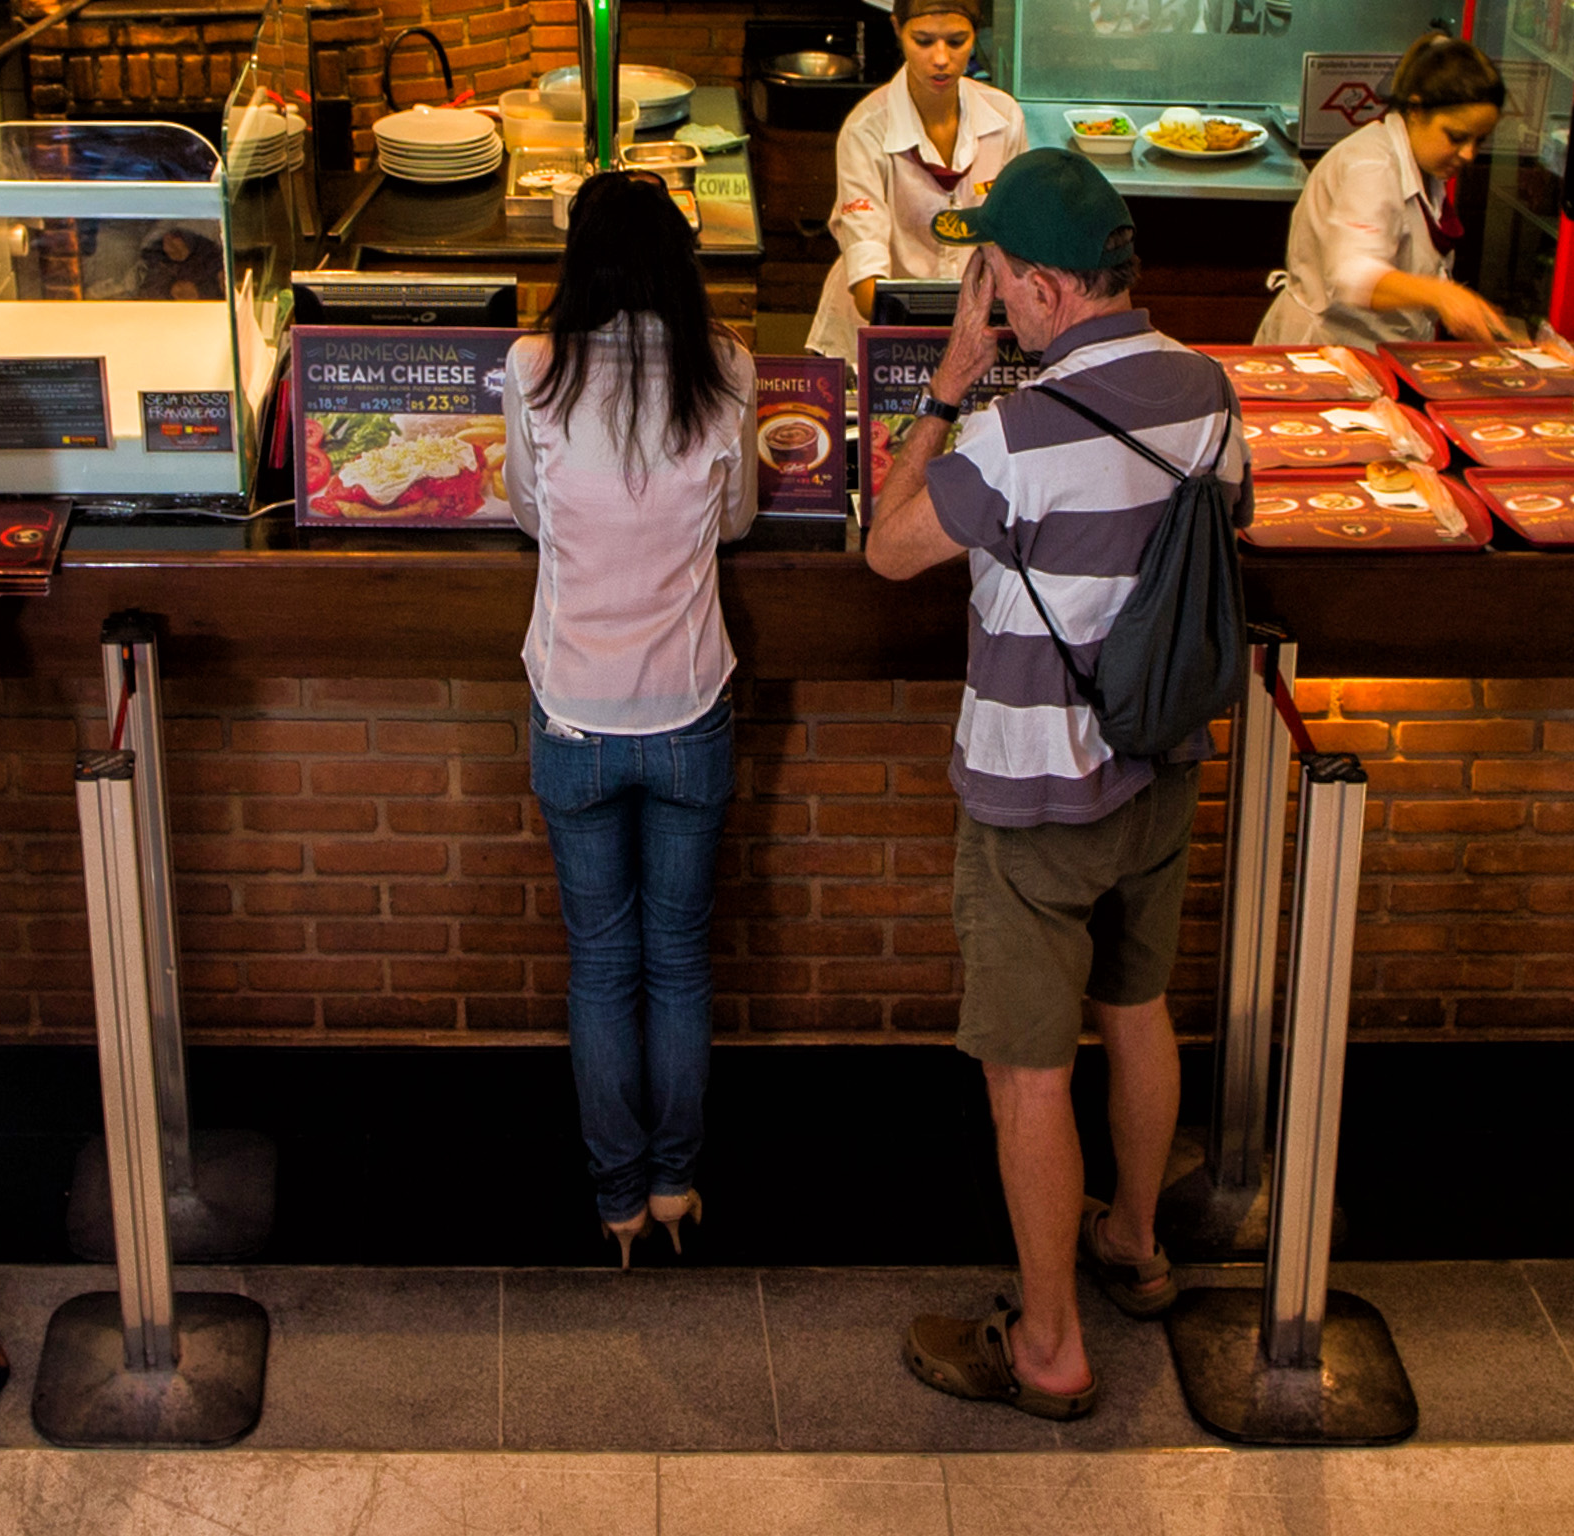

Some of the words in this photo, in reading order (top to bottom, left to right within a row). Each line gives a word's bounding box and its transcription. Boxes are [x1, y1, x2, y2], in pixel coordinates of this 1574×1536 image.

[324, 343, 460, 364] PARMEGIANA
[307, 364, 386, 384] CREAM
[391, 364, 476, 385] CHEESE
[182, 393, 230, 406] NOSSO
[147, 406, 227, 419] FRANQUEADO
